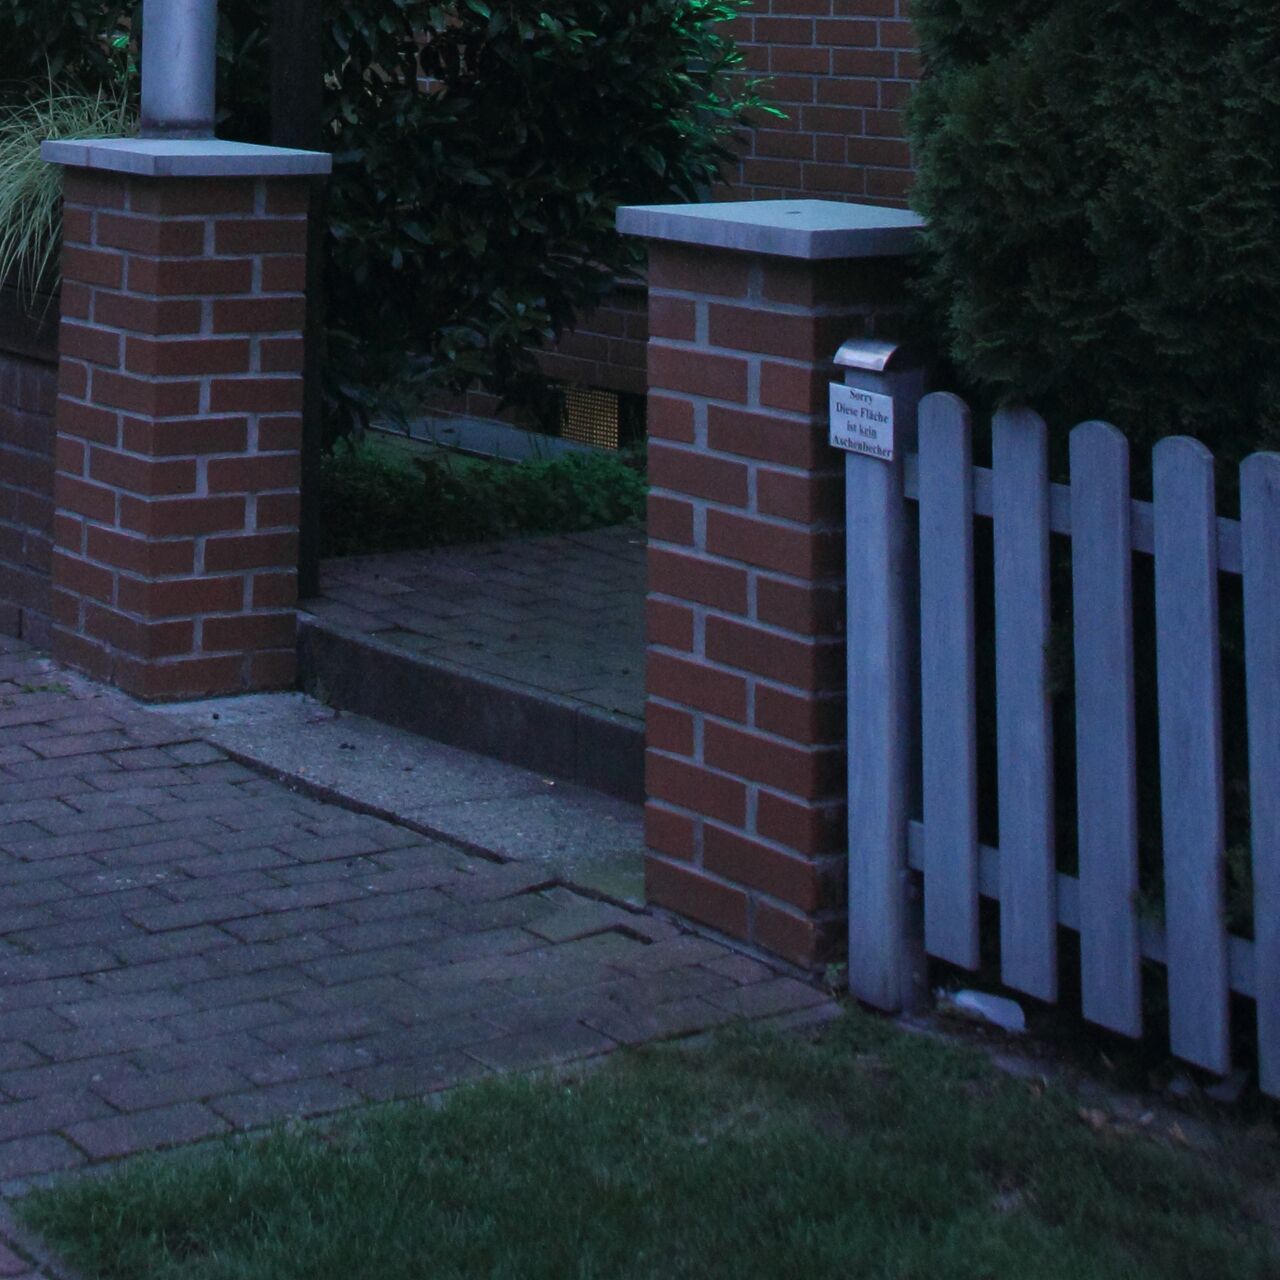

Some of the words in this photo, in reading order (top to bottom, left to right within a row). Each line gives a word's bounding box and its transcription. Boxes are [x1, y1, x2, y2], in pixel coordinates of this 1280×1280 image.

[850, 390, 872, 405] Sorry
[836, 402, 858, 416] Diese
[860, 407, 889, 424] Fläche
[847, 421, 857, 432] ist
[859, 424, 877, 438] kein
[833, 435, 892, 457] Aschenbecher
